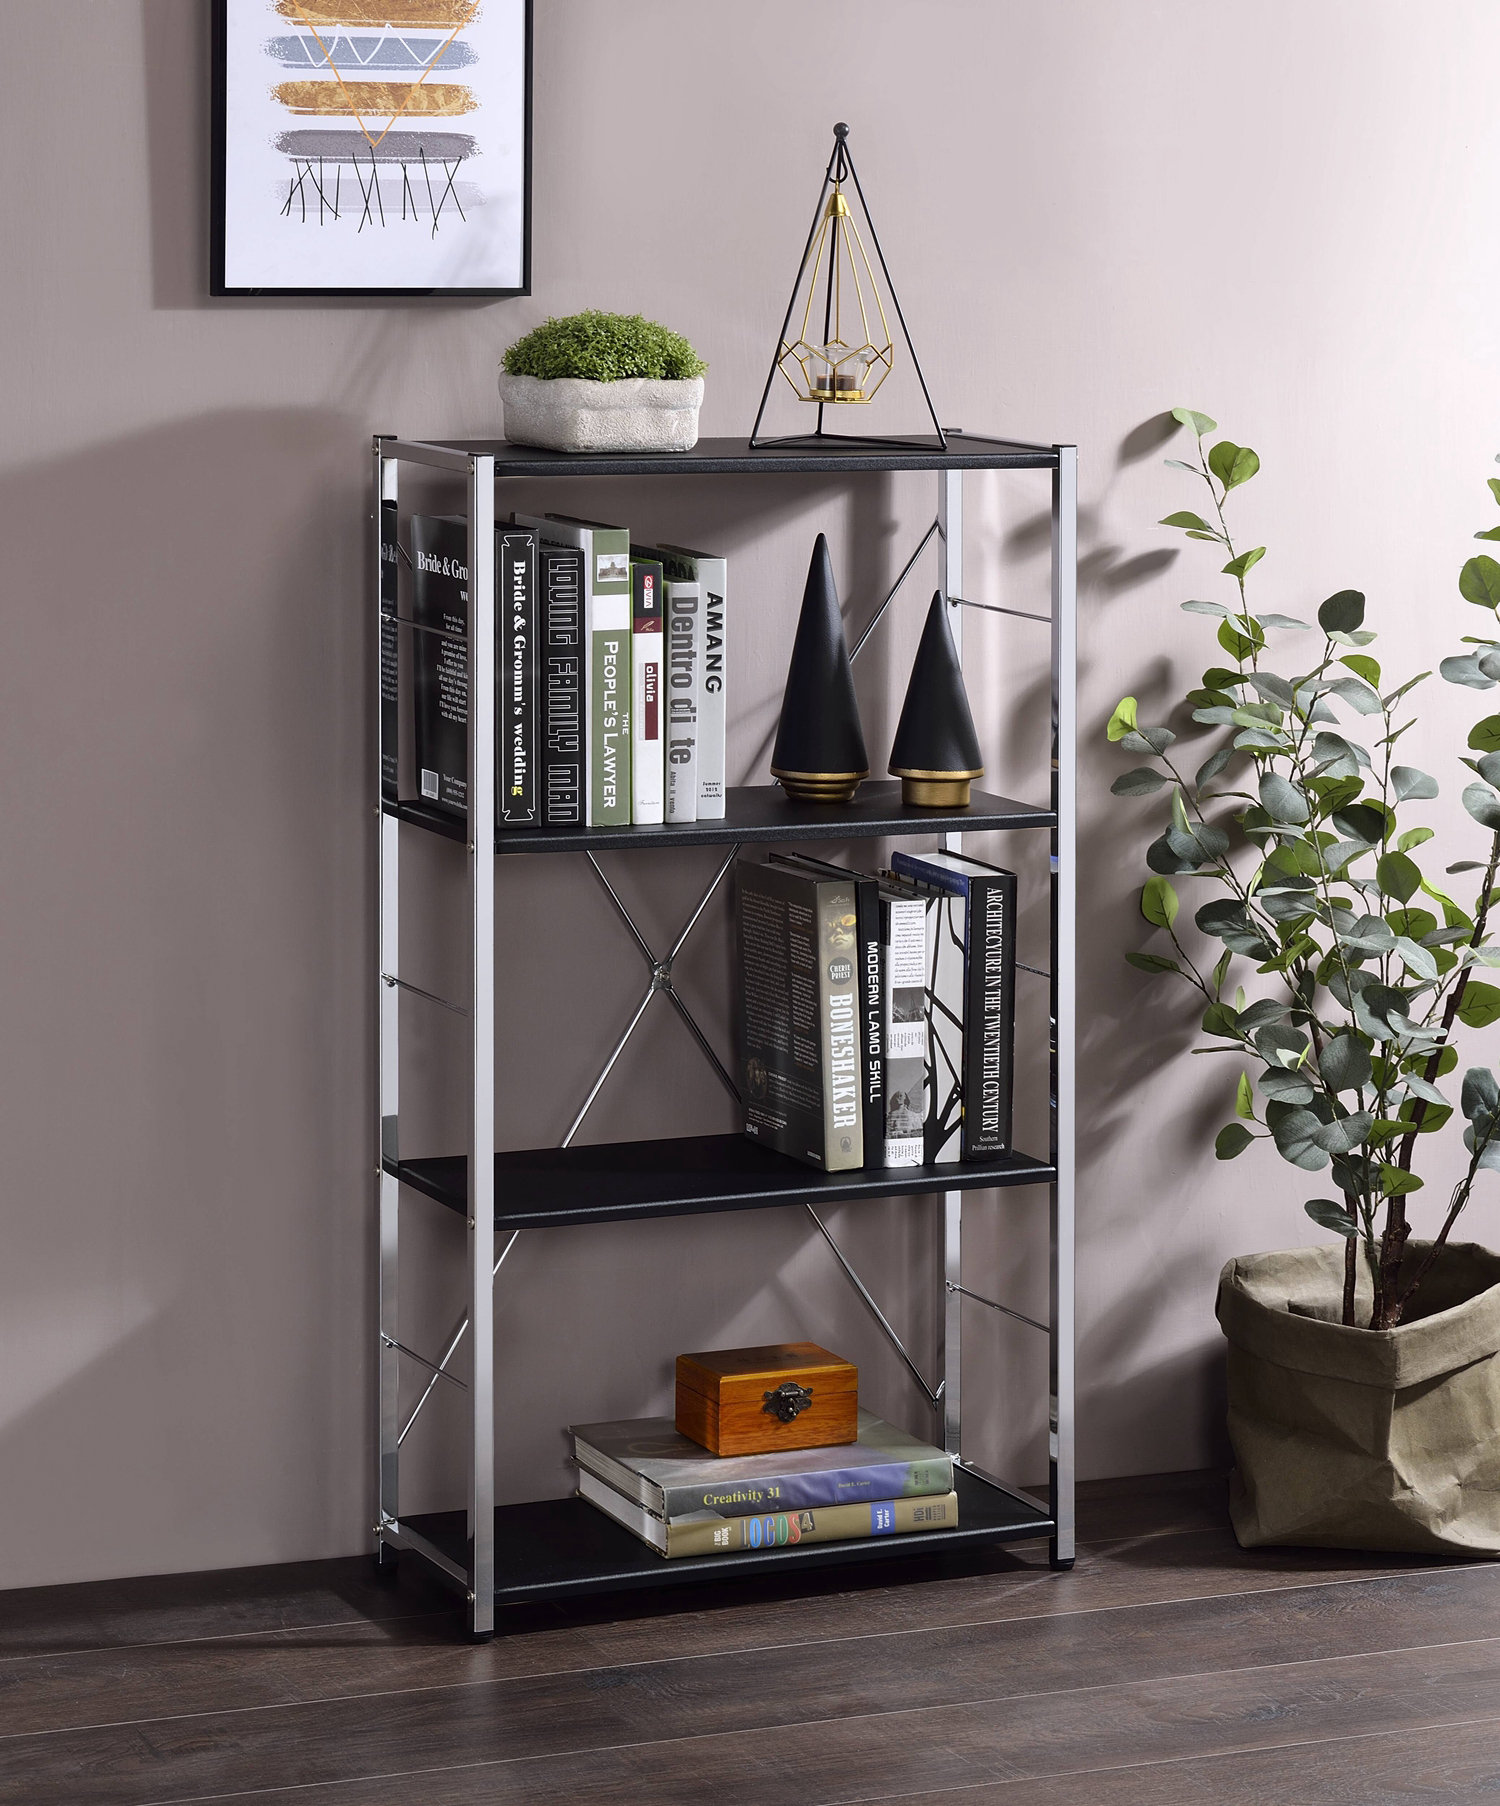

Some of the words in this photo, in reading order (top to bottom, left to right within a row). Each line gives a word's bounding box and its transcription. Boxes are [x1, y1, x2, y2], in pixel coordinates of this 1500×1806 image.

[417, 551, 442, 574] Bride
[442, 556, 451, 577] &
[513, 560, 526, 611] Bride
[513, 615, 527, 631] &
[670, 597, 698, 688] Dentro
[705, 592, 723, 694] AMANG
[603, 641, 619, 728] PEOPLE'S
[645, 665, 657, 702] olivia
[670, 698, 697, 723] di
[511, 722, 527, 796] wedding
[603, 732, 618, 808] LAWYER
[669, 737, 696, 765] te
[829, 964, 851, 973] CHERIE
[831, 971, 851, 980] PRIEST
[867, 941, 880, 1005] MODERN
[985, 975, 1002, 987] IN
[984, 989, 1002, 1012] THE
[868, 1010, 881, 1055] LAMO
[983, 1014, 1001, 1079] TWENTIETH
[829, 993, 856, 1128] BONESHAKER
[869, 1060, 882, 1104] SKILL
[982, 1081, 1000, 1132] CENTURY
[703, 1490, 763, 1505] Creativity
[767, 1487, 780, 1499] 31
[741, 1513, 801, 1549] LOGOS
